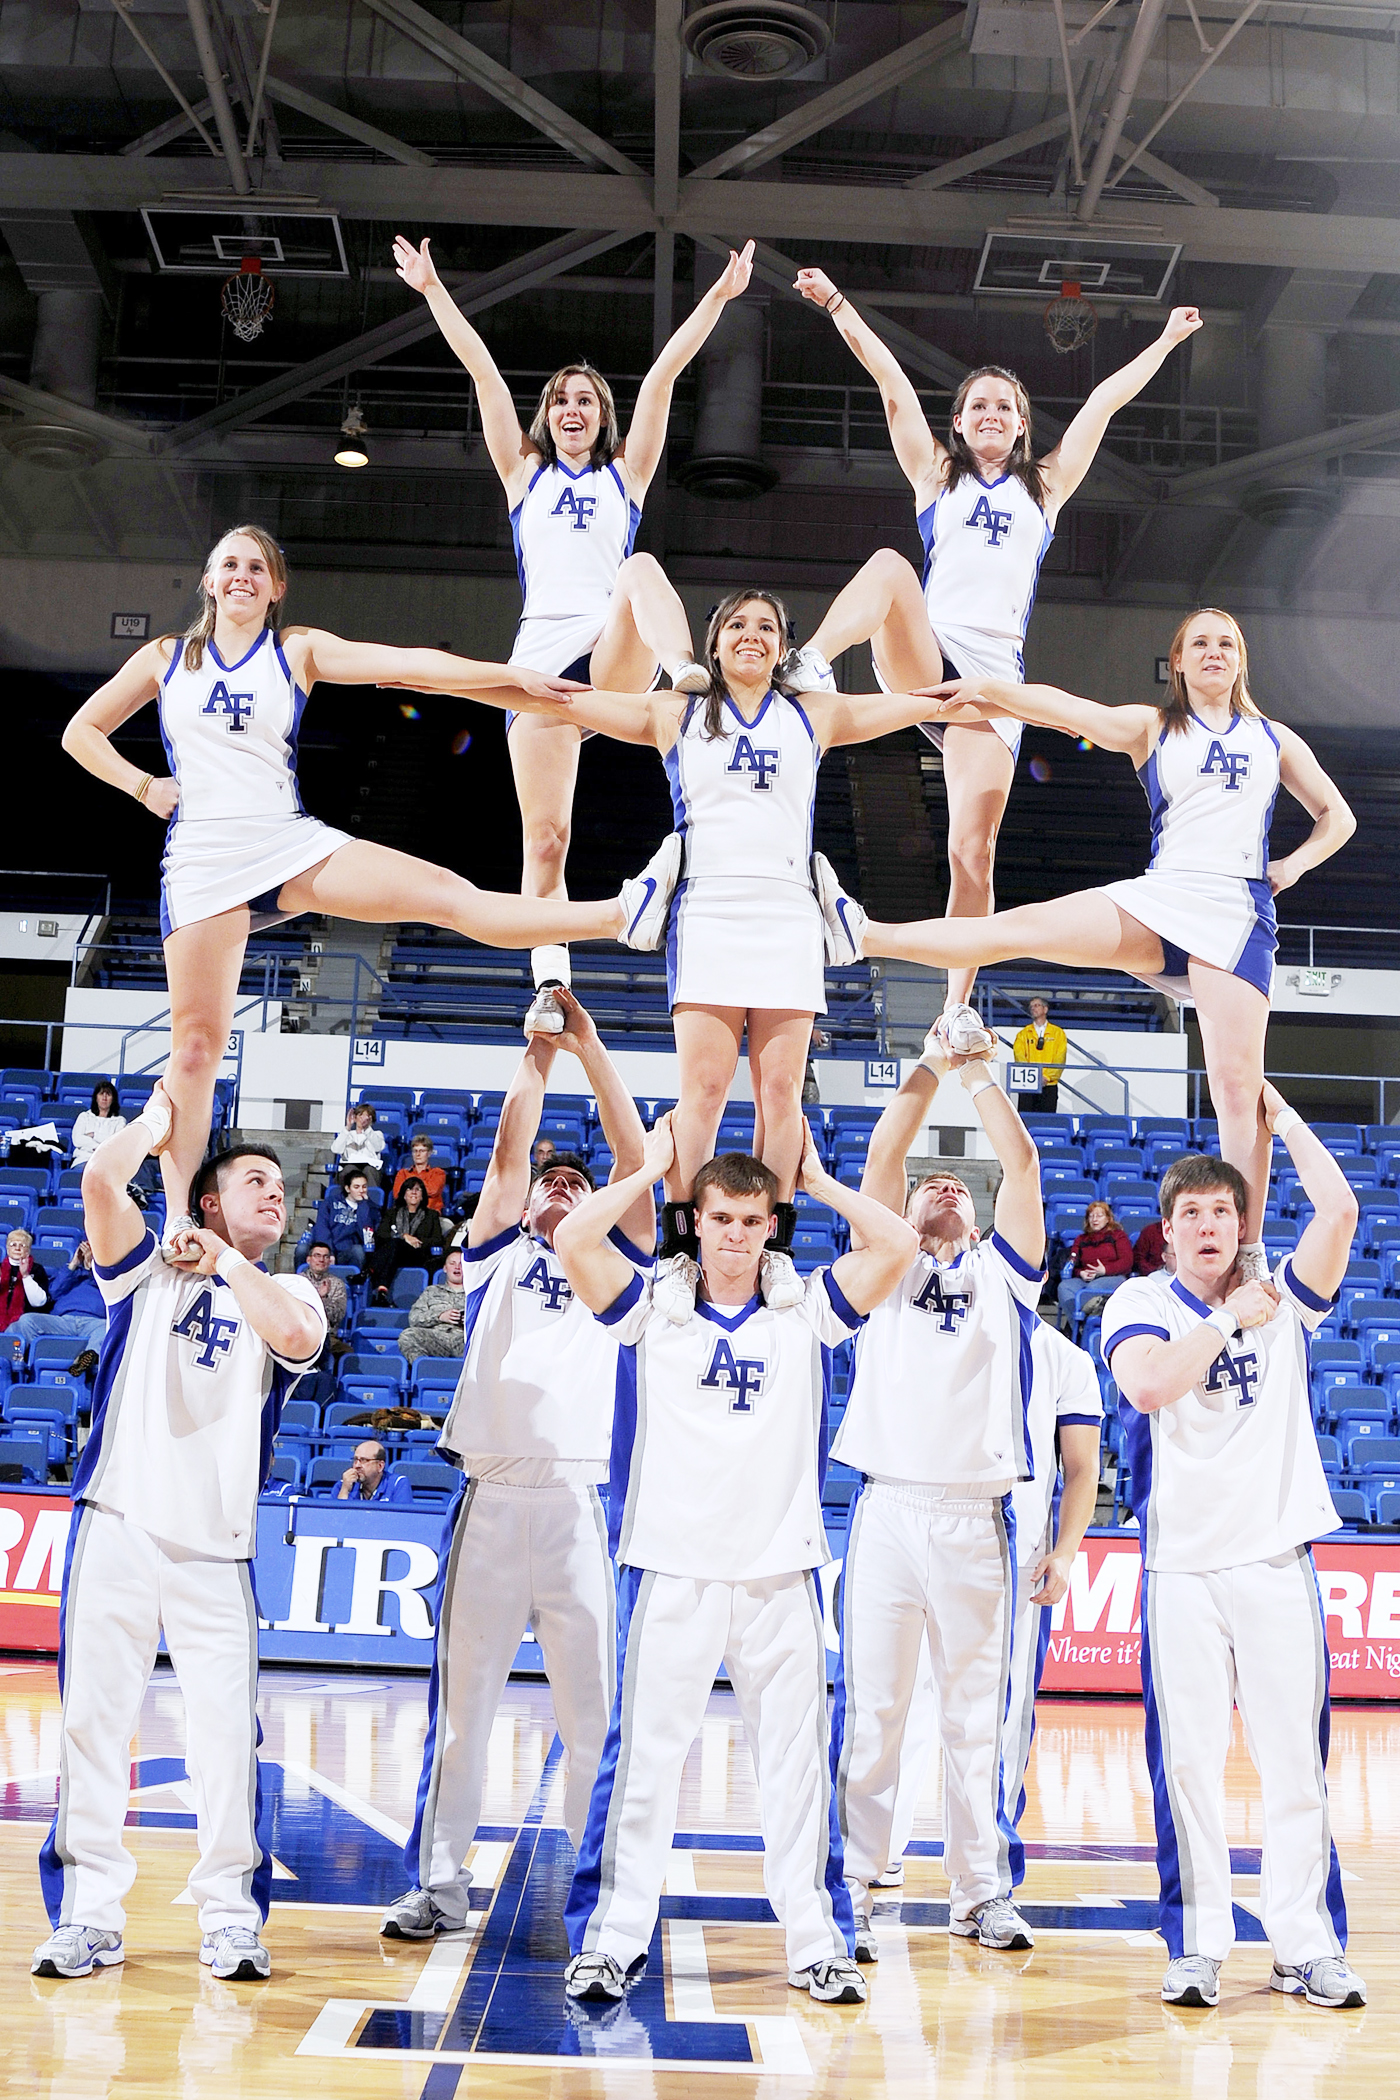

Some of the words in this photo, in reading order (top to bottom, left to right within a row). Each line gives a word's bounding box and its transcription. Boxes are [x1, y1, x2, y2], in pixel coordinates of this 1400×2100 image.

[550, 487, 597, 530] AF
[964, 495, 1013, 547] AF
[121, 618, 140, 627] U19
[201, 680, 255, 732] AF
[726, 734, 780, 790] AF
[1199, 740, 1250, 791] AF
[355, 1040, 379, 1056] L14
[871, 1063, 894, 1078] L14
[1012, 1068, 1036, 1084] L15
[516, 1256, 573, 1311] AF
[911, 1270, 970, 1334] AF
[171, 1288, 239, 1370] AF
[699, 1337, 766, 1413] AF
[1203, 1344, 1259, 1408] AF
[258, 1534, 439, 1639] IR
